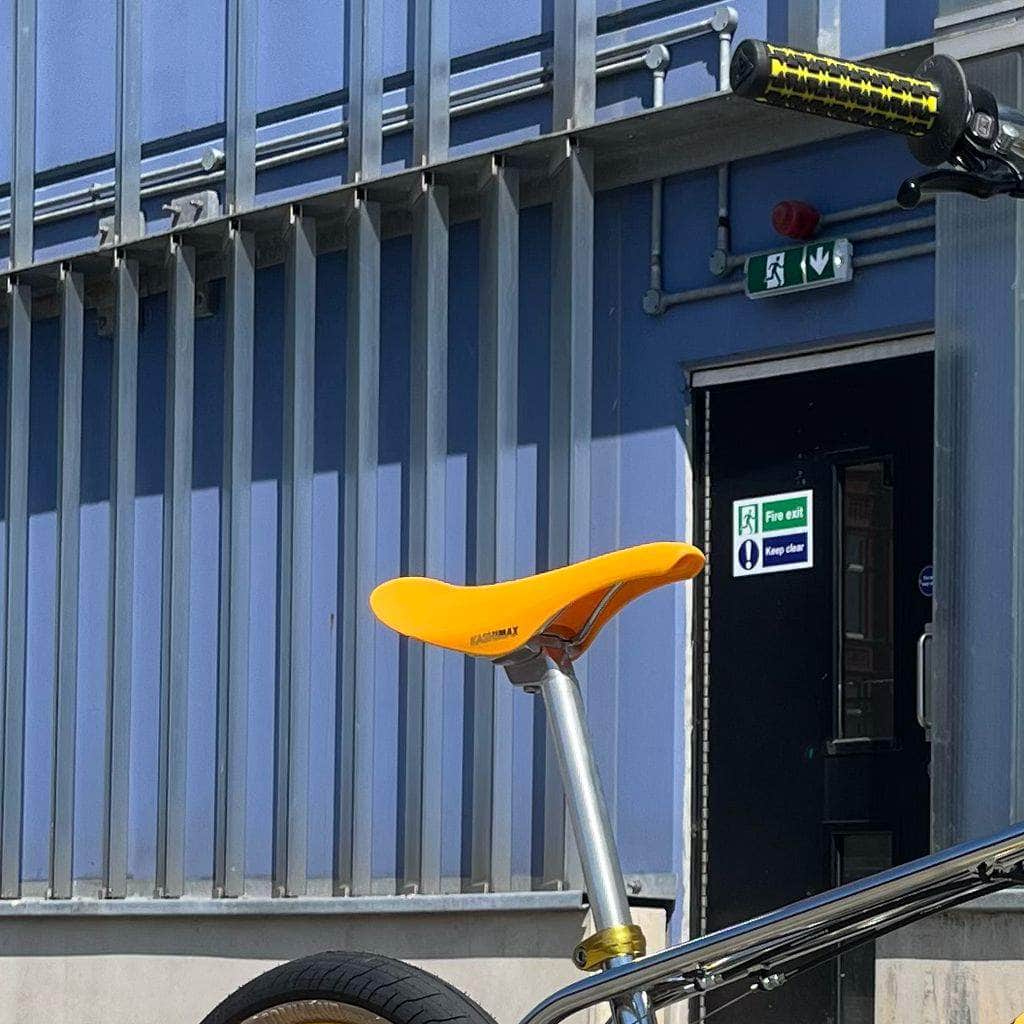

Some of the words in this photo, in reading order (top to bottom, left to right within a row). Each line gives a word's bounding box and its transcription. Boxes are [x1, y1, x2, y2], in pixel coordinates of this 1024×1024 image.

[765, 510, 784, 524] Fire
[785, 506, 804, 521] exit
[765, 546, 785, 557] Keep
[785, 542, 805, 554] clear
